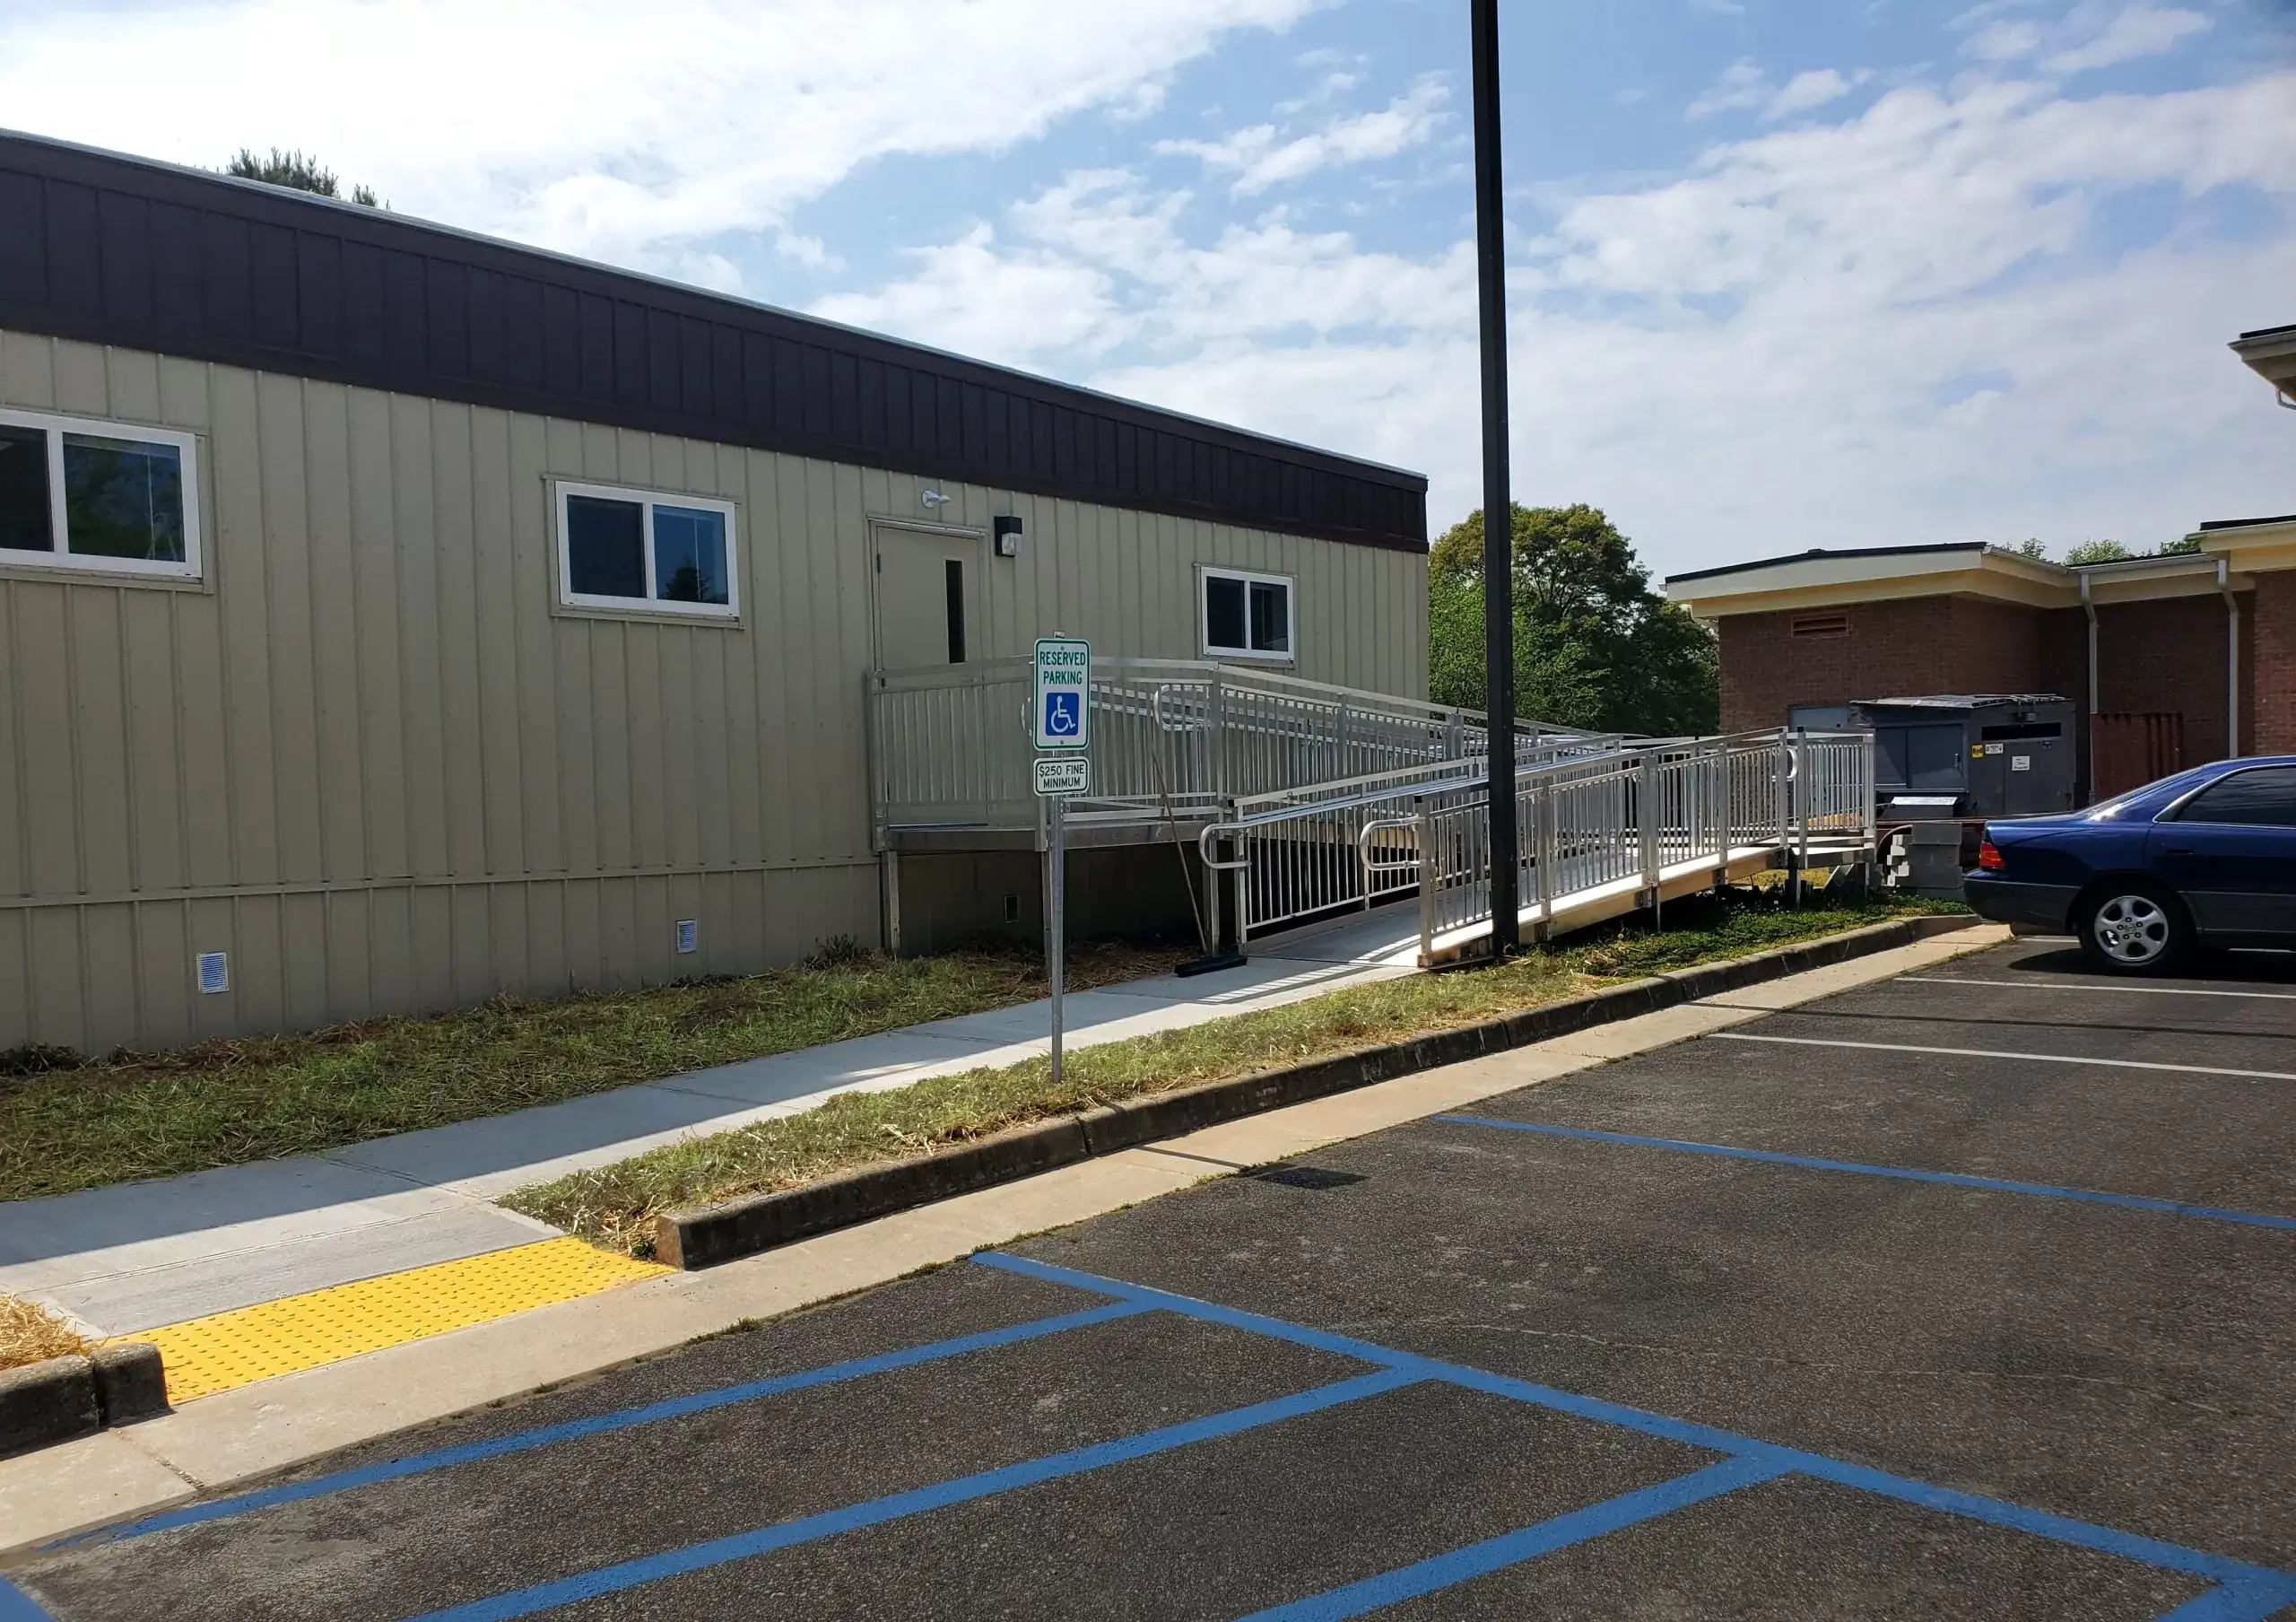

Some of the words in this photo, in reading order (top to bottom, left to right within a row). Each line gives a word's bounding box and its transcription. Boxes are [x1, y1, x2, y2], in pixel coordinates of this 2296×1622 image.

[1039, 651, 1086, 666] RESERVED
[1043, 670, 1083, 685] PARKING
[1039, 765, 1063, 778] $250
[1065, 763, 1085, 775] FINE
[1043, 776, 1081, 789] MINIMUM
